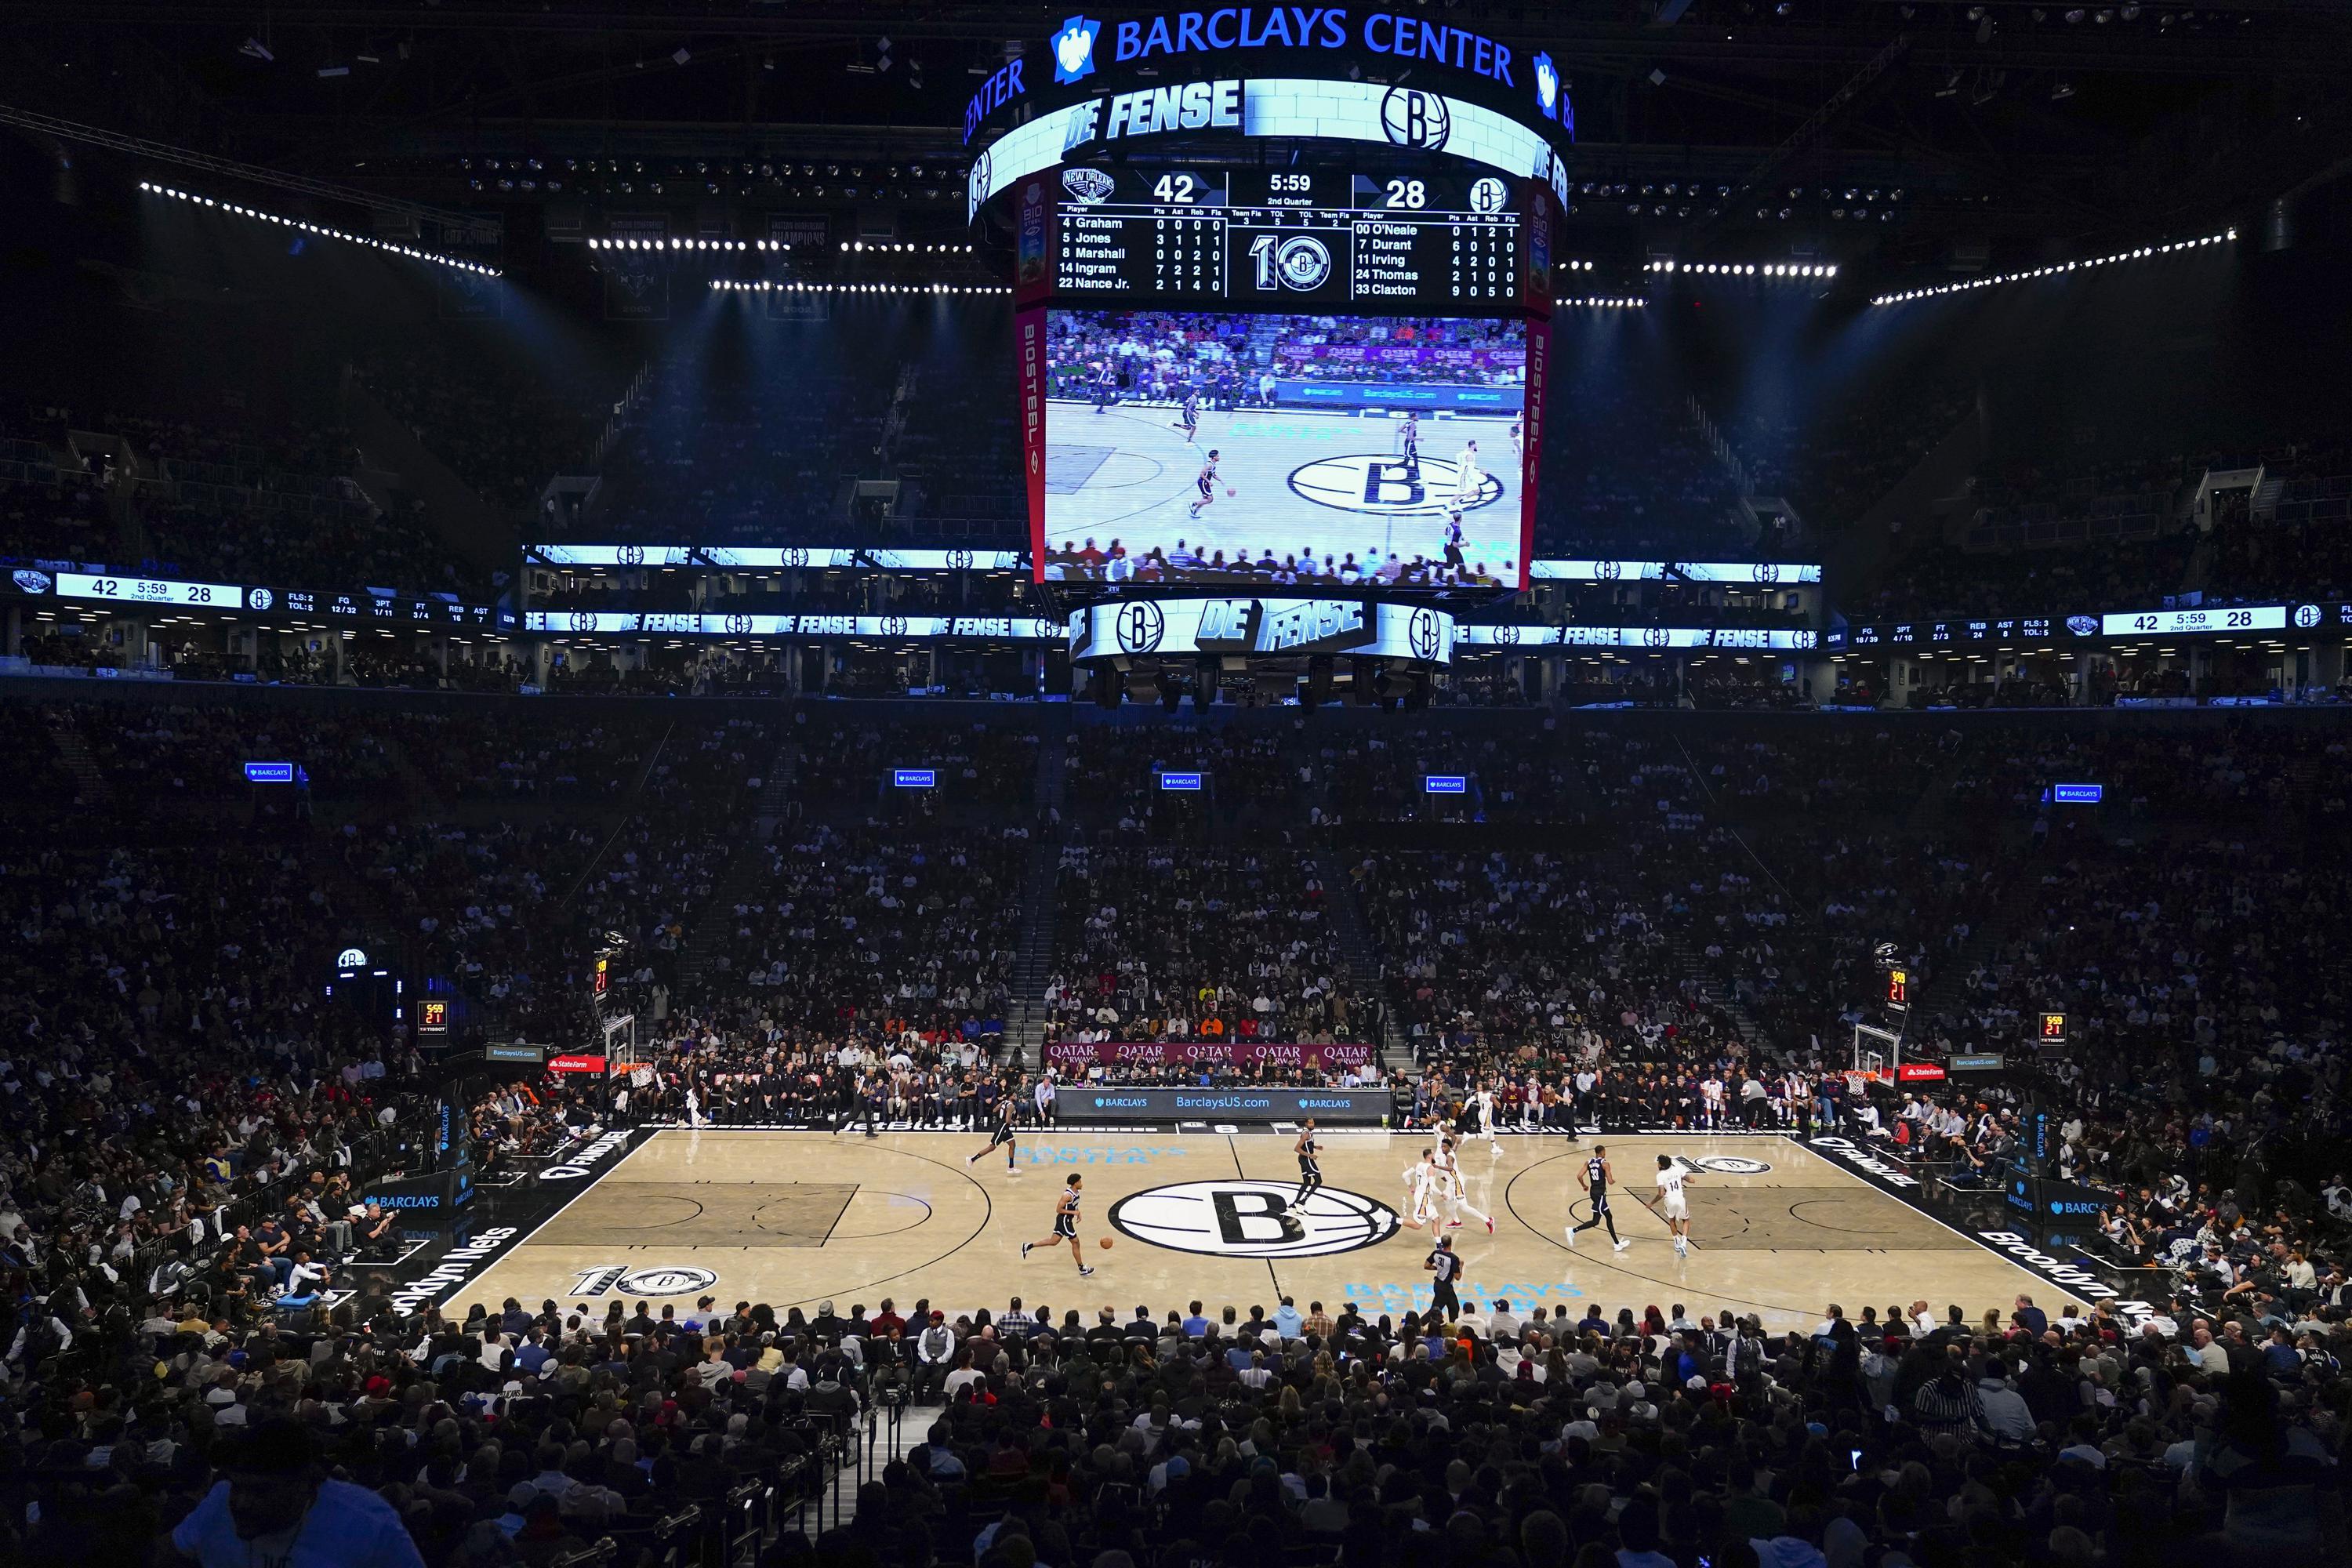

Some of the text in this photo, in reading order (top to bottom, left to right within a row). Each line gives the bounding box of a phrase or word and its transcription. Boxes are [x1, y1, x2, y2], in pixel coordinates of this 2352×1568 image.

[1116, 7, 1515, 88] BARCLAYS CENTER
[964, 58, 1025, 146] CENTER
[1063, 79, 1240, 153] DE FENSE
[1063, 171, 1115, 189] NEW ORLEANS
[1271, 175, 1310, 191] 5:59
[1154, 175, 1193, 202] 42
[1387, 180, 1425, 208] 28
[1023, 205, 1043, 220] BIO
[1063, 217, 1220, 230] 4 Graham 0 0 0 0
[1356, 224, 1513, 237] 00 O'Neale 0 1 2 1
[1063, 233, 1110, 243] 5 Jones
[1359, 239, 1411, 250] 7 Durant
[1063, 248, 1124, 259] 8 Marshall
[1358, 254, 1405, 267] 11 Irving
[1060, 263, 1116, 275] 14 Ingram
[1356, 269, 1418, 280] 24 Thomas
[1059, 278, 1129, 289] 22 Nance Jr.
[1356, 284, 1513, 297] 33 Claxton 9 0 5 0
[1024, 323, 1038, 445] BIOSTEEL
[1529, 335, 1544, 452] BIOSTEEL
[831, 549, 855, 567] DE
[1799, 564, 1821, 583] DE
[93, 579, 211, 602] 42 5:59 28
[621, 613, 700, 632] DE FENSE
[1198, 599, 1365, 652] DE FENSE
[2134, 612, 2252, 630] 42 5:59 28
[1563, 627, 1621, 645] FENSE
[596, 973, 605, 992] 21
[1893, 971, 1906, 984] 5:59
[1891, 983, 1904, 1001] 21
[426, 1004, 444, 1014] 5:59
[426, 1014, 441, 1023] 21
[2046, 1016, 2063, 1025] 5:59
[2045, 1025, 2060, 1035] 21
[493, 1050, 536, 1058] BarclaysUS.com
[1050, 1045, 1368, 1059] QATAR QATAR QATAR QATAR
[1105, 1097, 1350, 1109] BARCLAYS BarclaysUS.com BARCLAYS
[568, 1129, 635, 1167] FANDUEL
[1591, 1169, 1600, 1181] 33
[1839, 1148, 1920, 1188] FANDUEL
[1669, 1181, 1679, 1192] 14
[380, 1196, 439, 1207] BARCLAYS
[455, 1187, 474, 1206] BARCLAYS
[2008, 1193, 2033, 1211] BARCLAYS
[451, 1227, 517, 1260] Nets
[1438, 1257, 1445, 1267] 31
[1978, 1232, 2120, 1297] Brooklyn
